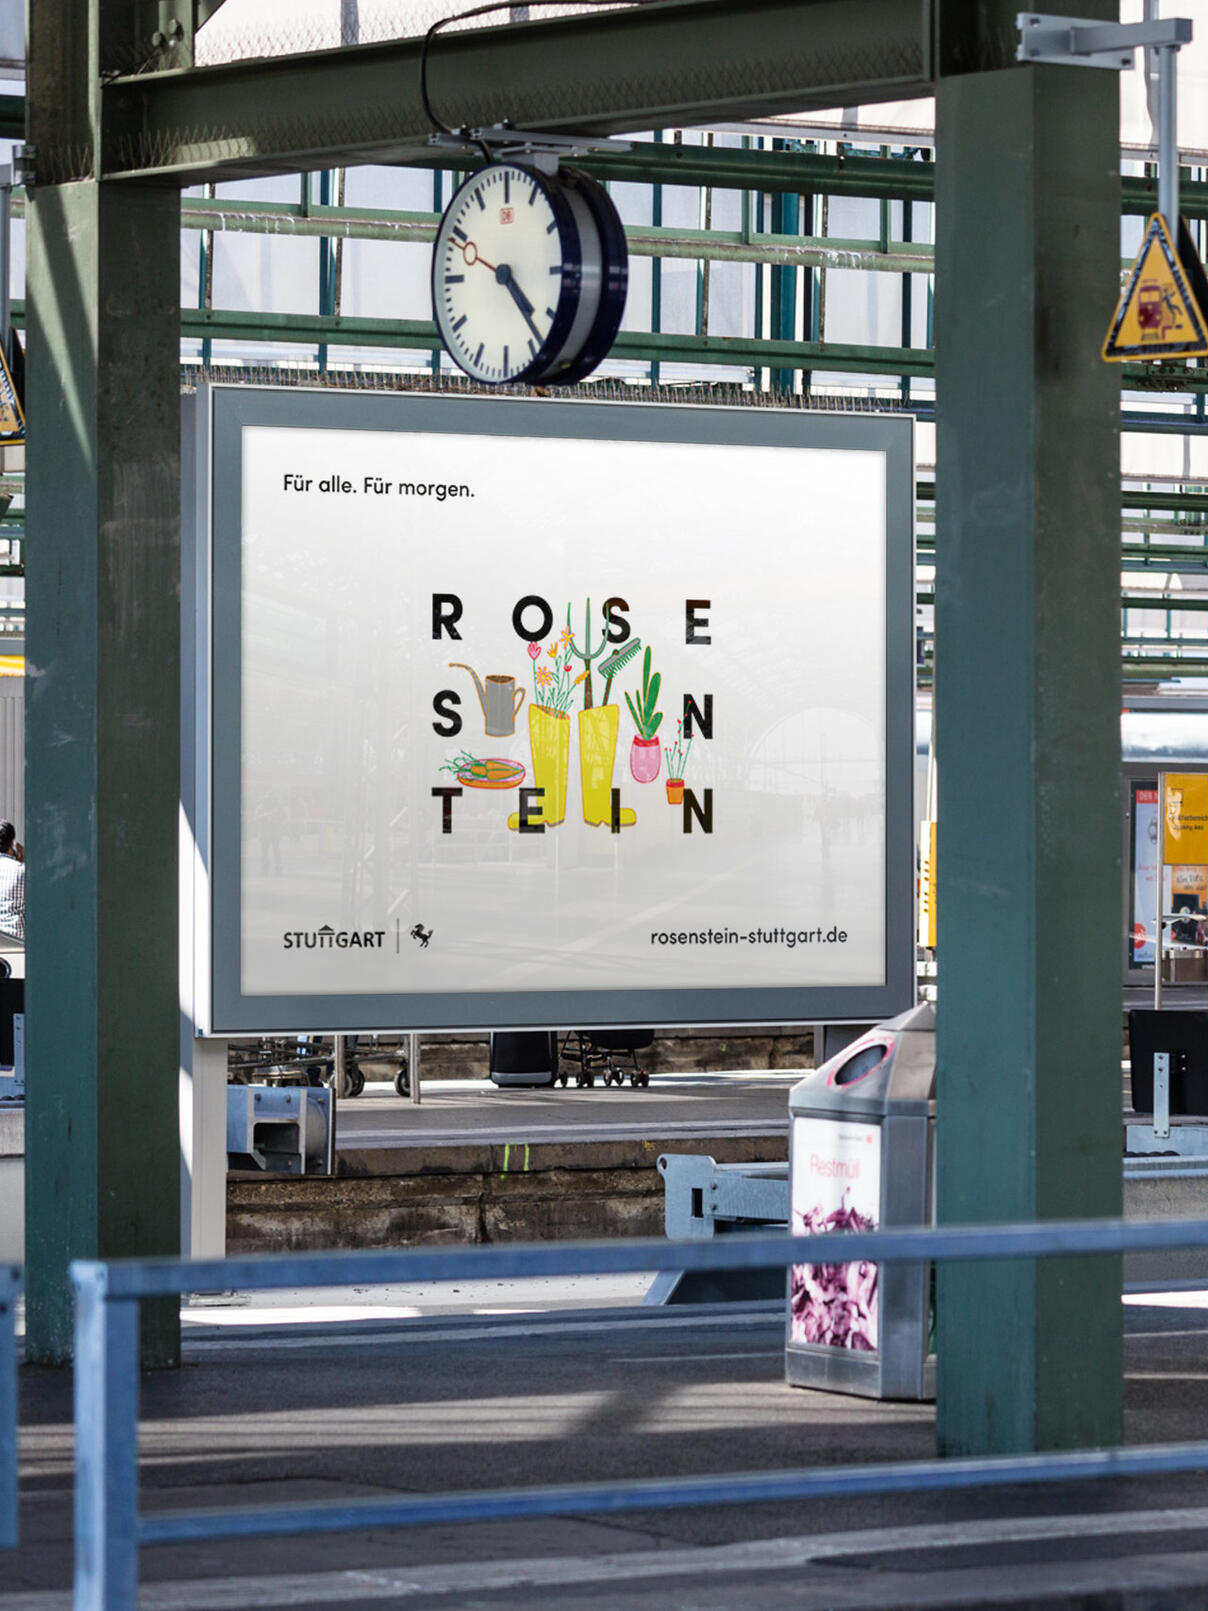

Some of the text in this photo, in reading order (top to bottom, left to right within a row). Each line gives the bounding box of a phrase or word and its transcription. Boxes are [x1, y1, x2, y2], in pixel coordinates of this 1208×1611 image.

[283, 473, 475, 502] Für alle. Für morgen.
[283, 925, 386, 949] STUTTGART
[651, 926, 848, 949] rosenstein-stuttgart.de
[810, 1153, 860, 1179] Restmüll
